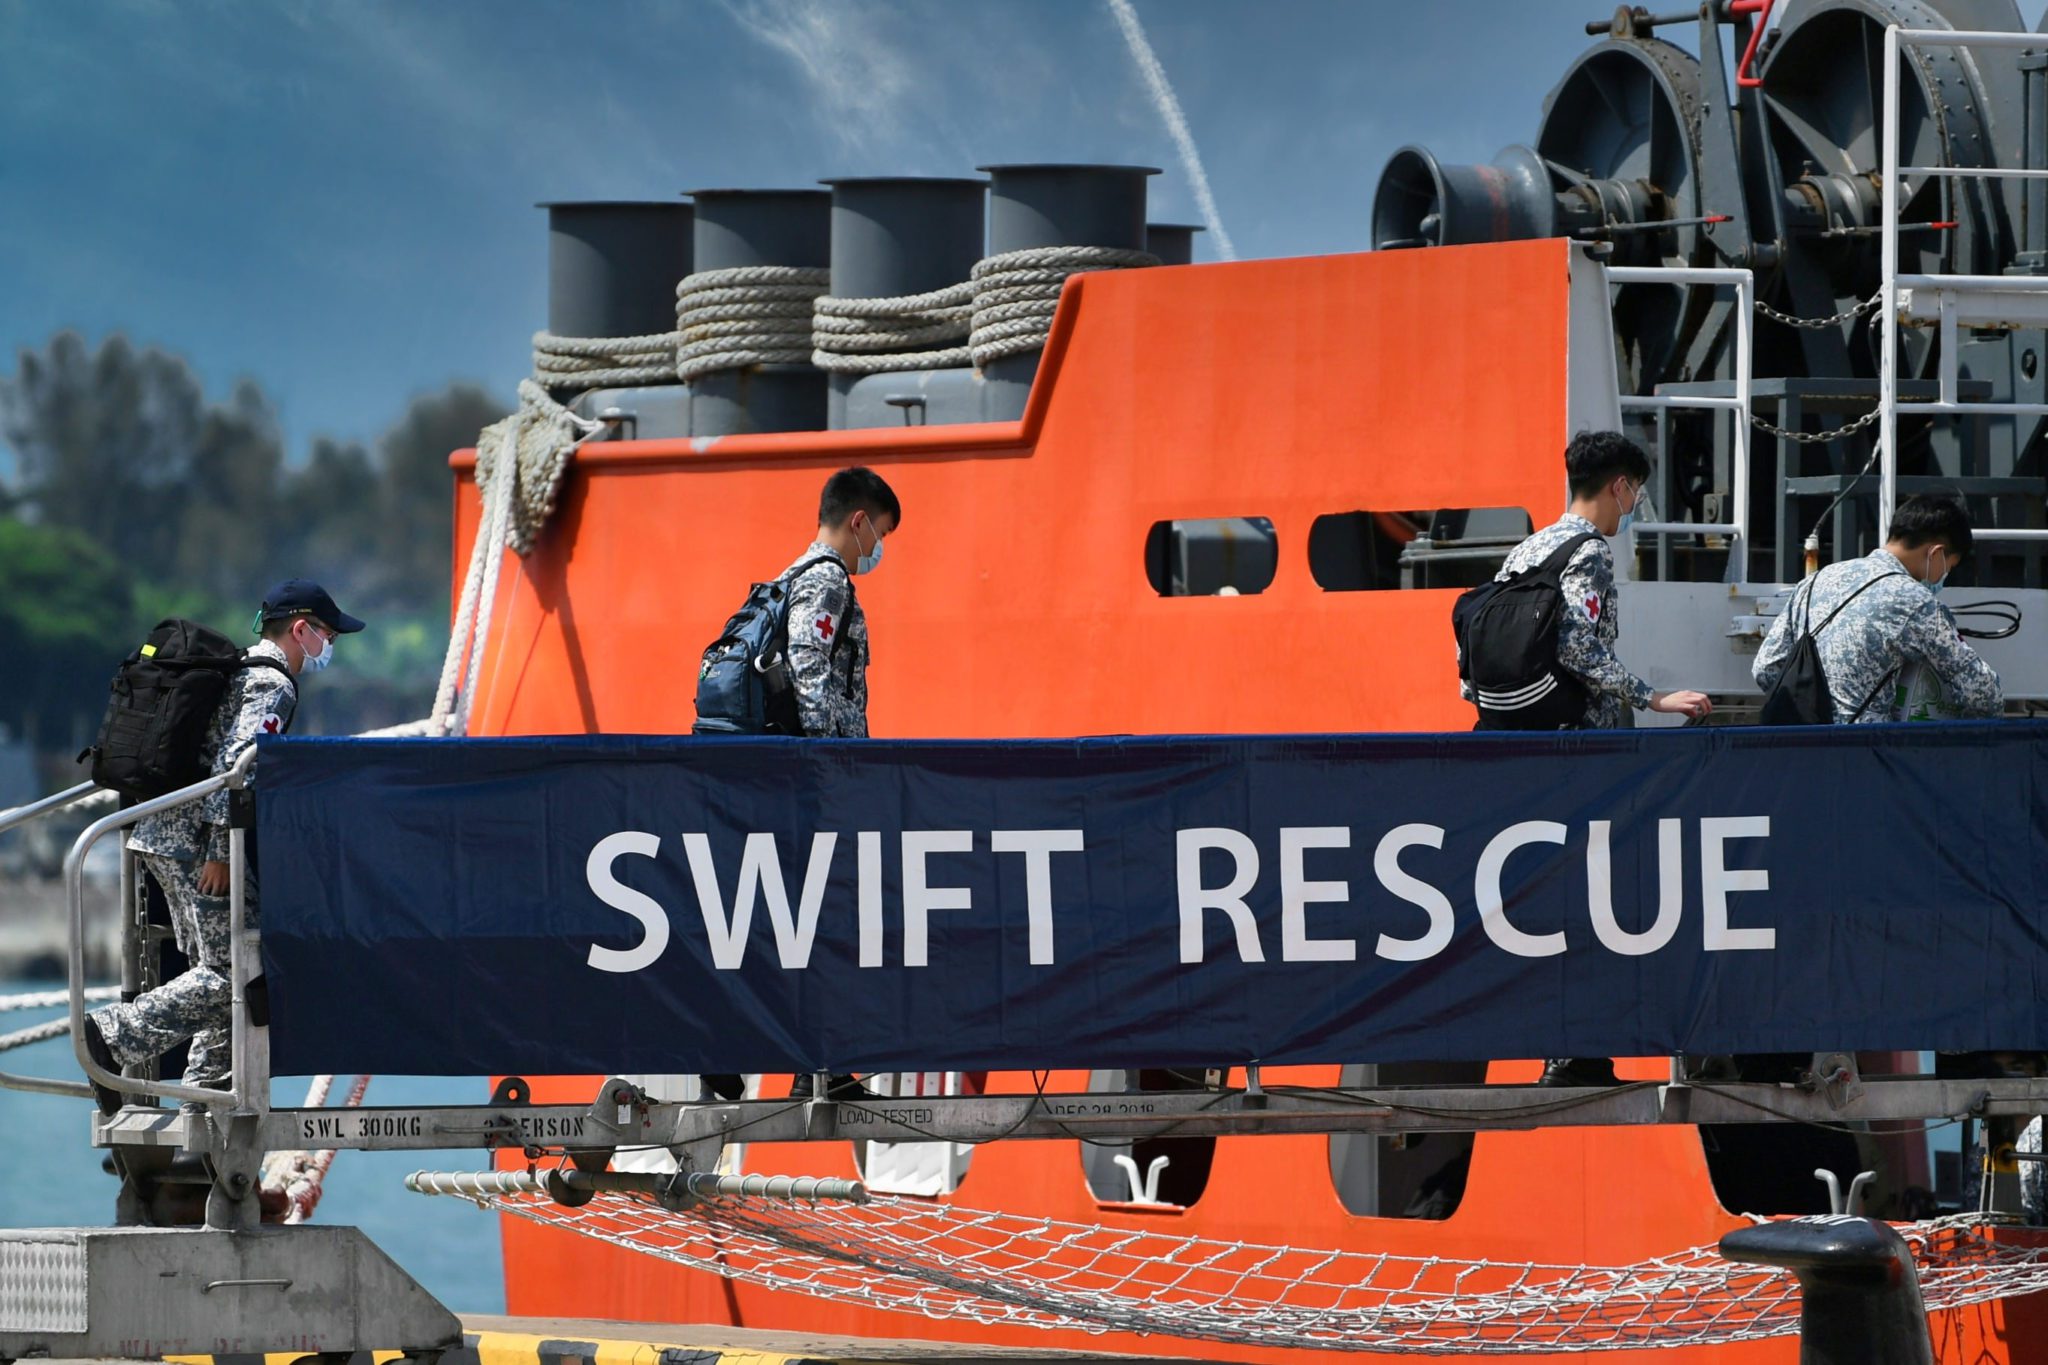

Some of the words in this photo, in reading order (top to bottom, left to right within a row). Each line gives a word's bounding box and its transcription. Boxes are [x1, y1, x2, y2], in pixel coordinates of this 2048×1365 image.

[586, 829, 1084, 972] SWIFT
[1176, 816, 1776, 963] RESCUE
[303, 1118, 344, 1139] SWL
[358, 1116, 421, 1137] 300KG
[508, 1117, 583, 1138] ERSON
[839, 1110, 874, 1125] LOAD
[881, 1109, 933, 1124] TESTED
